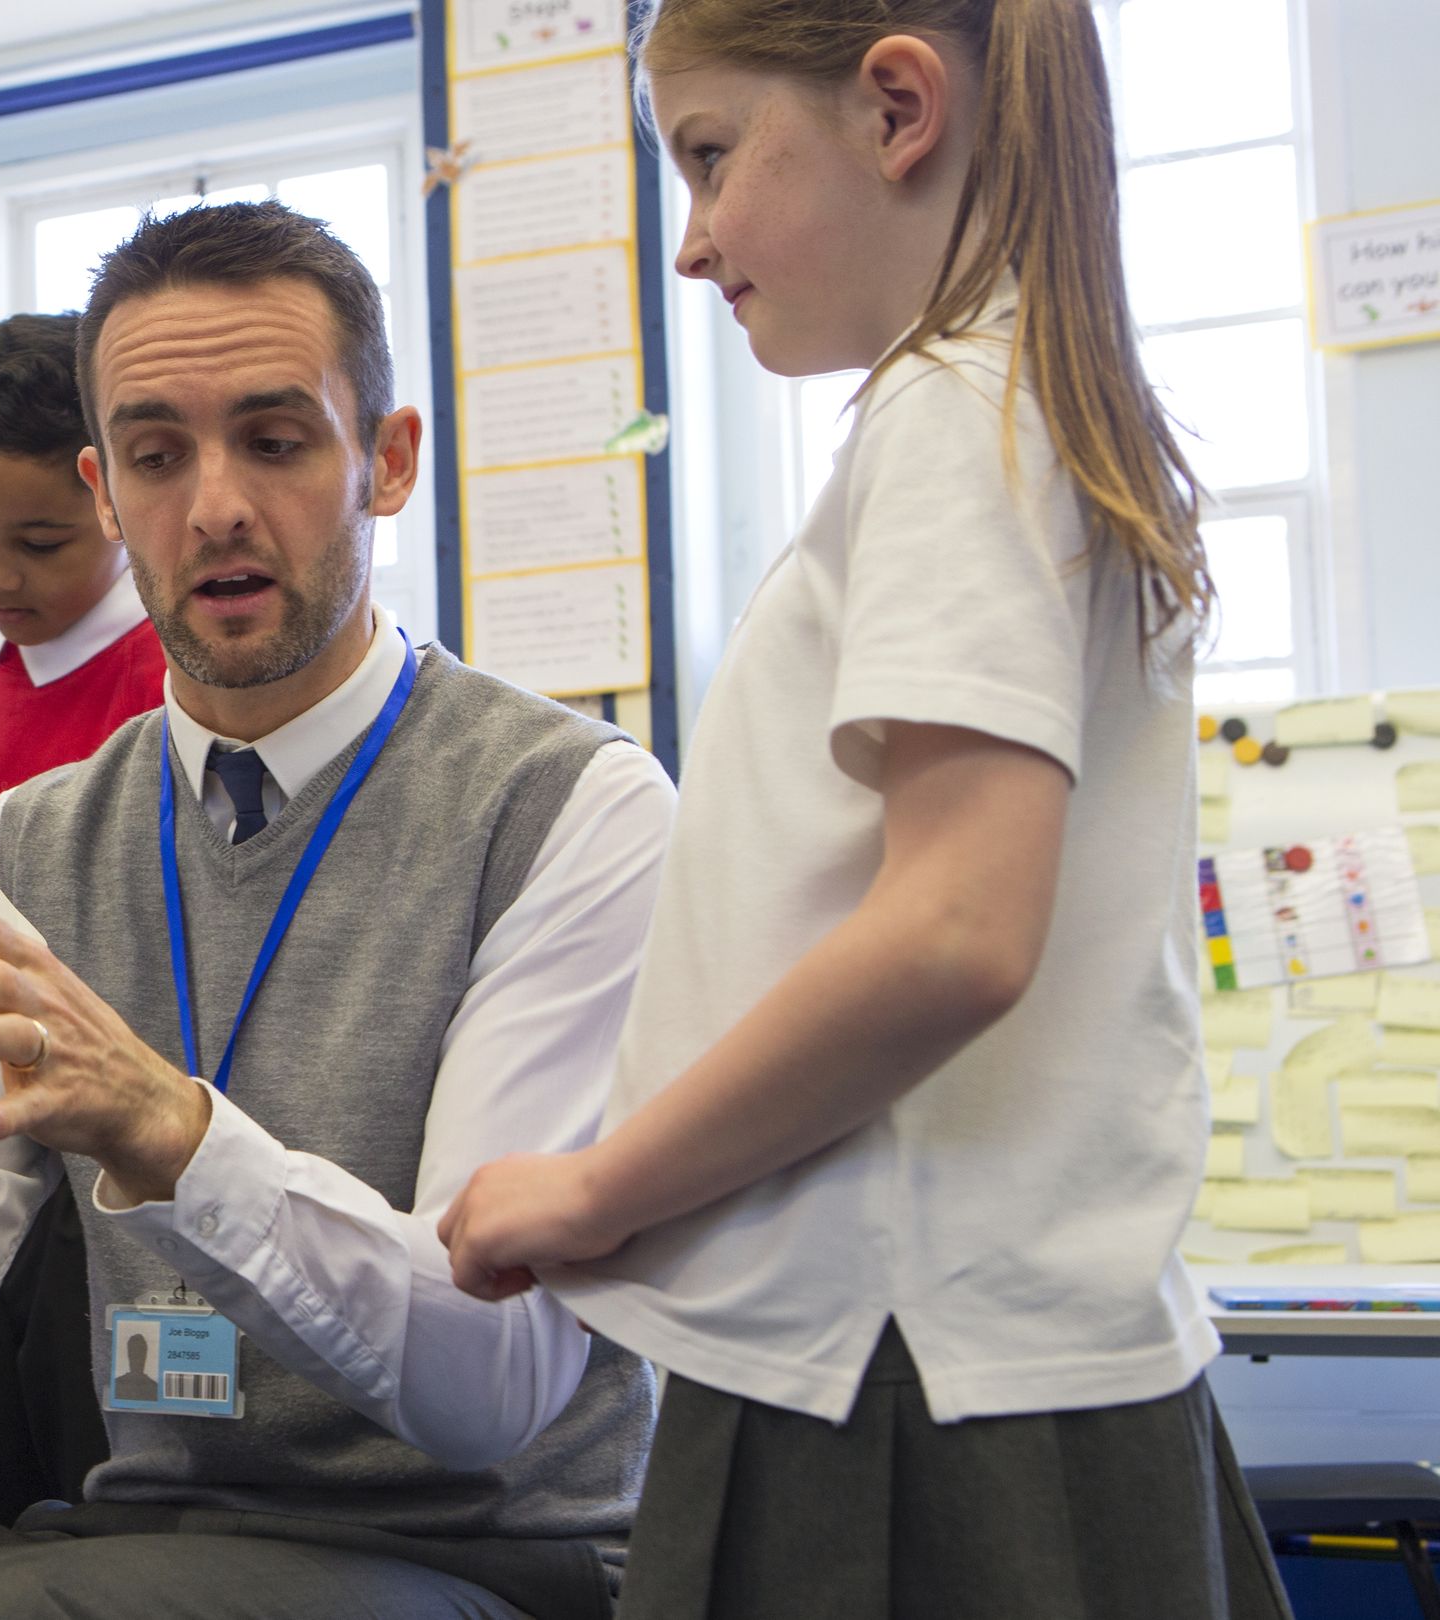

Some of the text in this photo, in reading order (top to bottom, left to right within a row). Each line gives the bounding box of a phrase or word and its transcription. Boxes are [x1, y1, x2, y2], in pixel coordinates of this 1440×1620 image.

[1350, 239, 1408, 265] How
[1338, 271, 1439, 303] can you
[168, 1328, 209, 1339] Joe Bloggs
